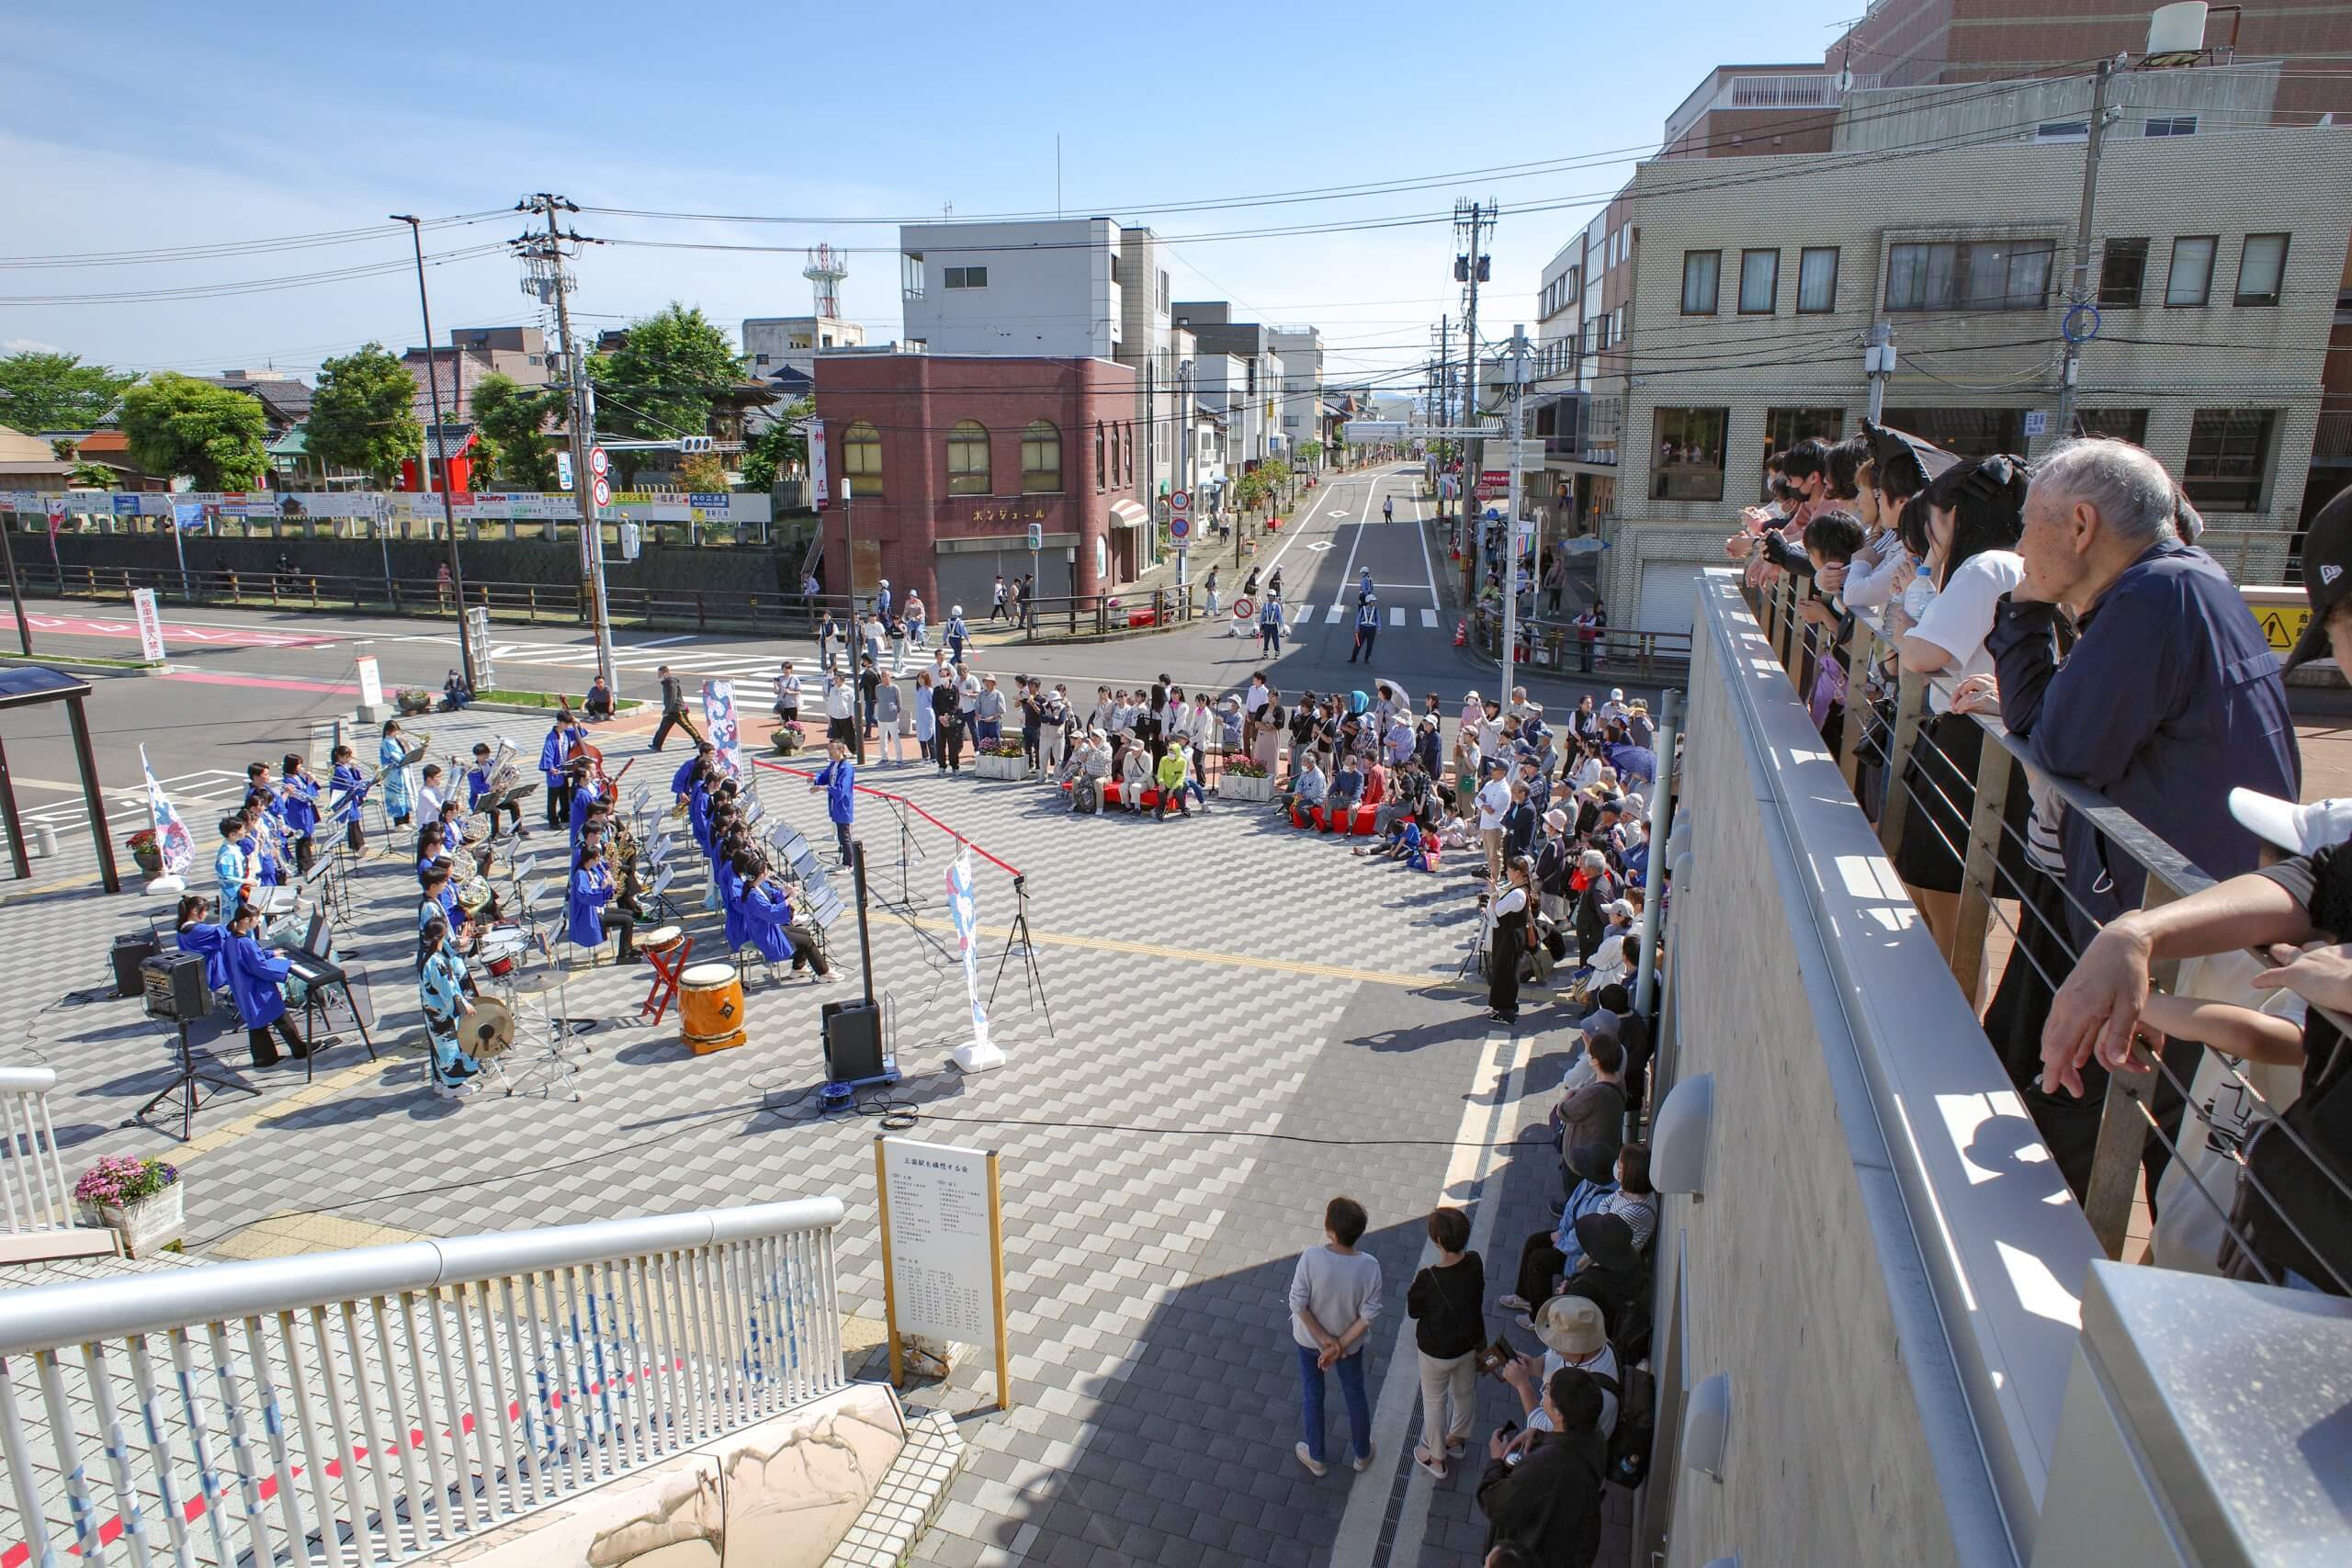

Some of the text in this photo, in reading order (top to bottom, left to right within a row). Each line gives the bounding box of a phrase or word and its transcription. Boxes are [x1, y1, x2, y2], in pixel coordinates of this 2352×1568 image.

[595, 456, 605, 468] 40
[1174, 495, 1185, 504] 40
[139, 592, 161, 658] 一般車両進入禁止
